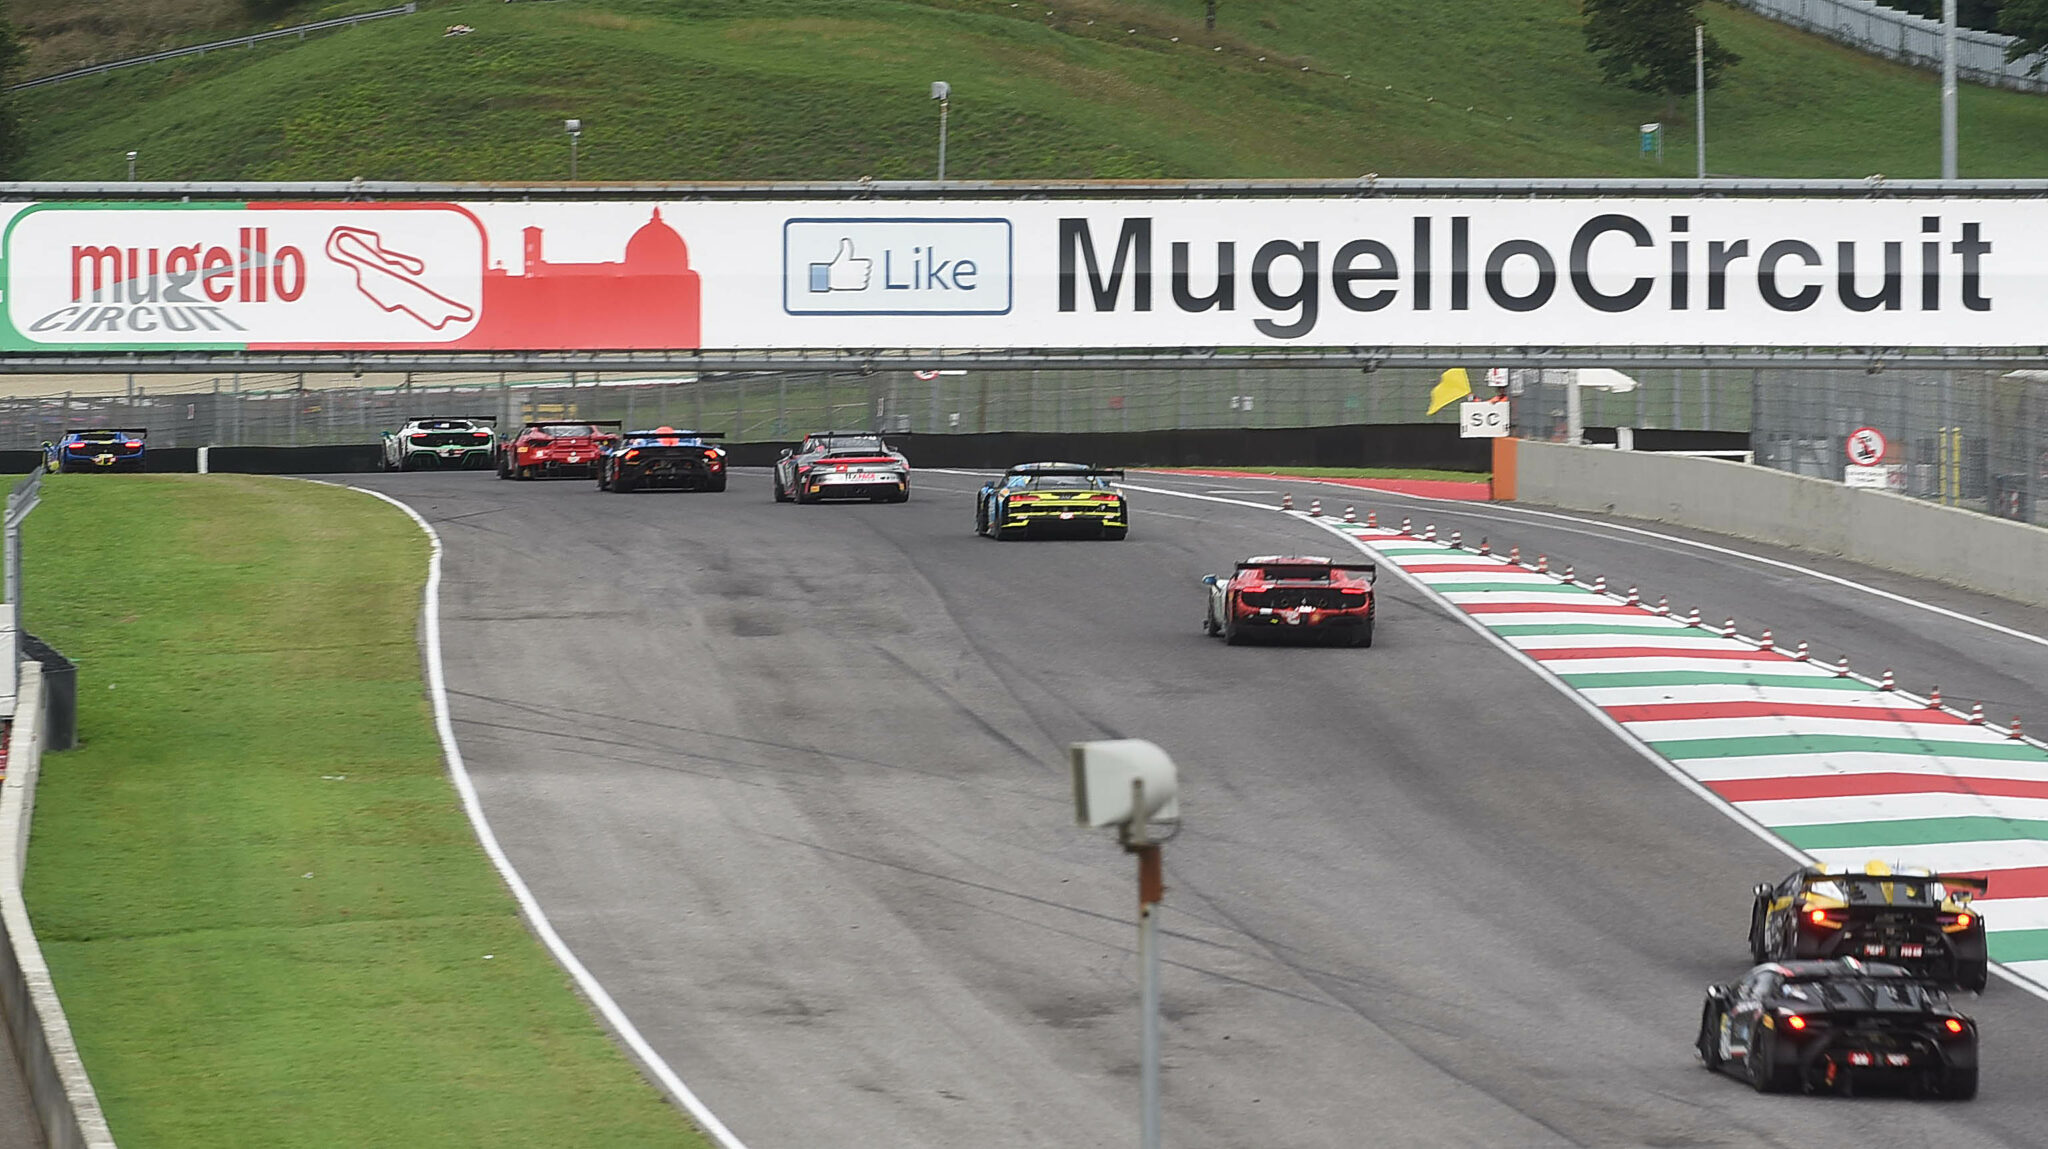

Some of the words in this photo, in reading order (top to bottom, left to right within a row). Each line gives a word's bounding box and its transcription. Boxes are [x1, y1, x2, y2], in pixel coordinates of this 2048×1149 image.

[71, 227, 306, 304] mugello
[885, 246, 977, 291] Like
[1059, 213, 1992, 338] MugelloCircuit
[28, 305, 250, 333] CIRCUIT
[1470, 412, 1501, 428] SC
